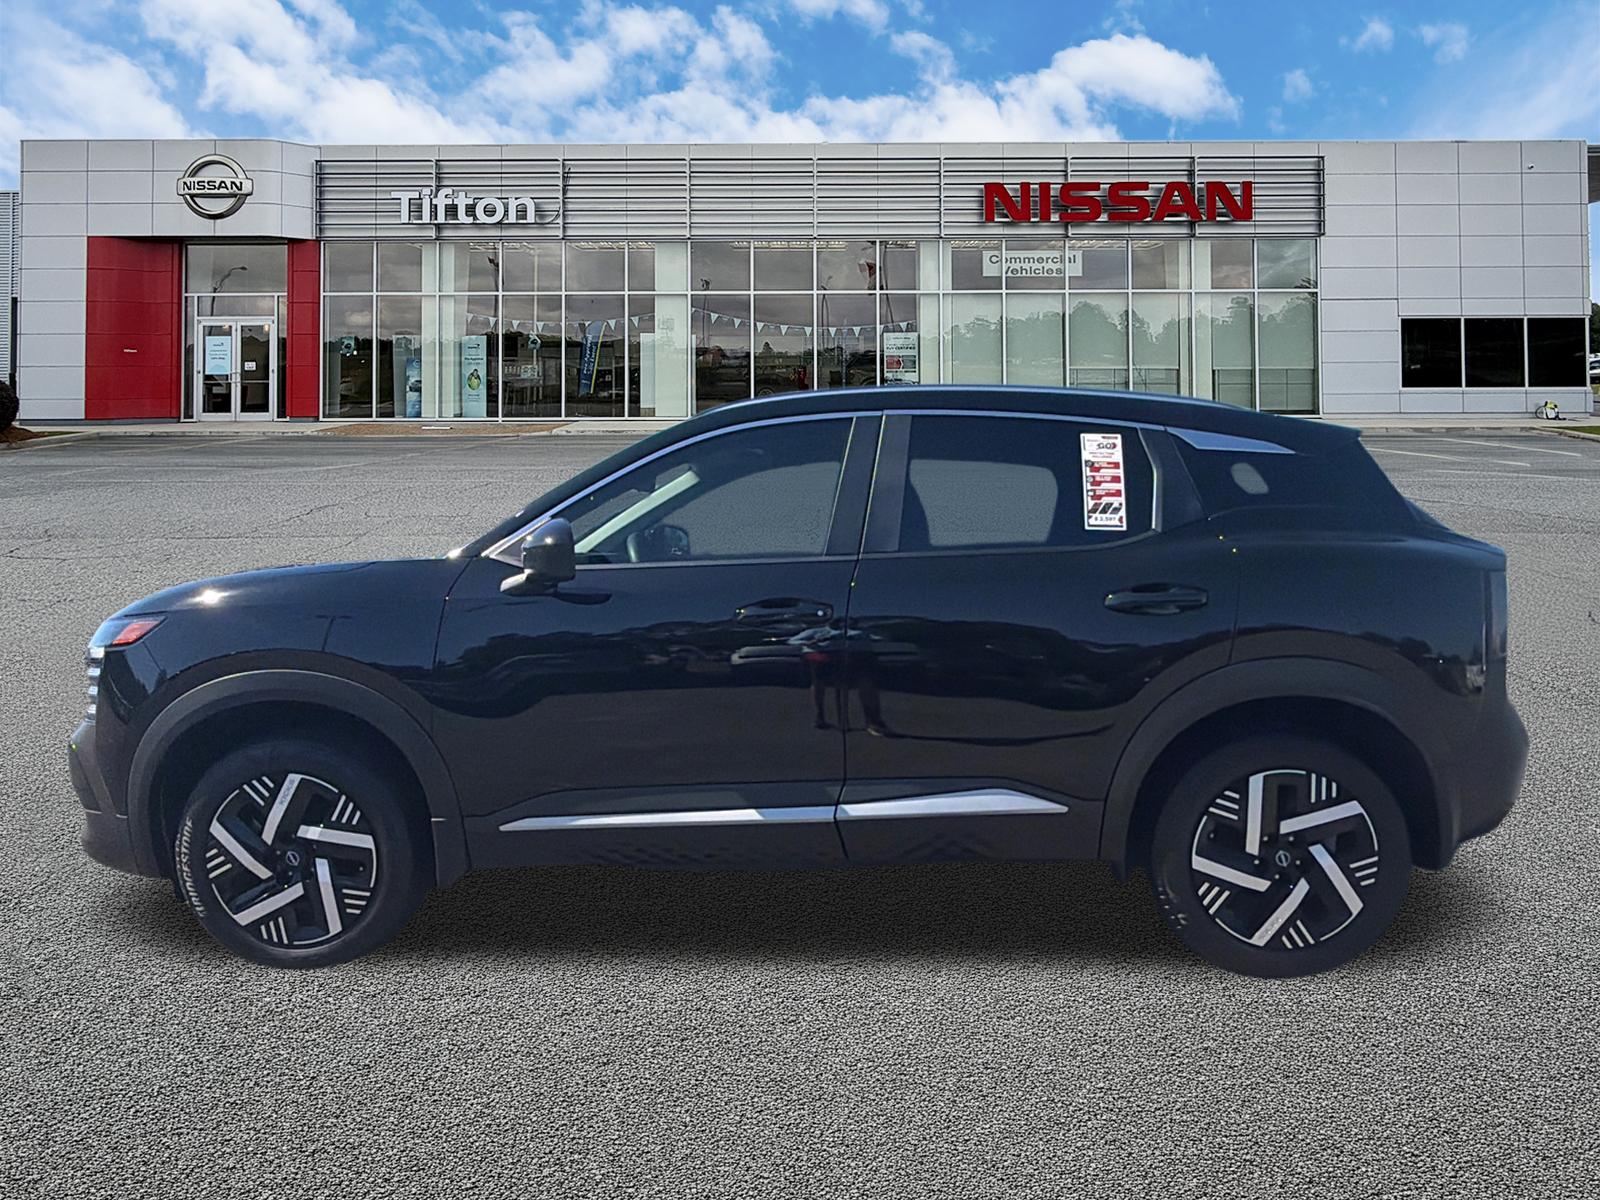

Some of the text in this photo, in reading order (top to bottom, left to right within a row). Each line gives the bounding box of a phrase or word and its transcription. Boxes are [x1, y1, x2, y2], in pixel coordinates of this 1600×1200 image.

[183, 180, 243, 191] NISSAN
[984, 181, 1253, 222] NISSAN
[391, 188, 536, 224] Tifton
